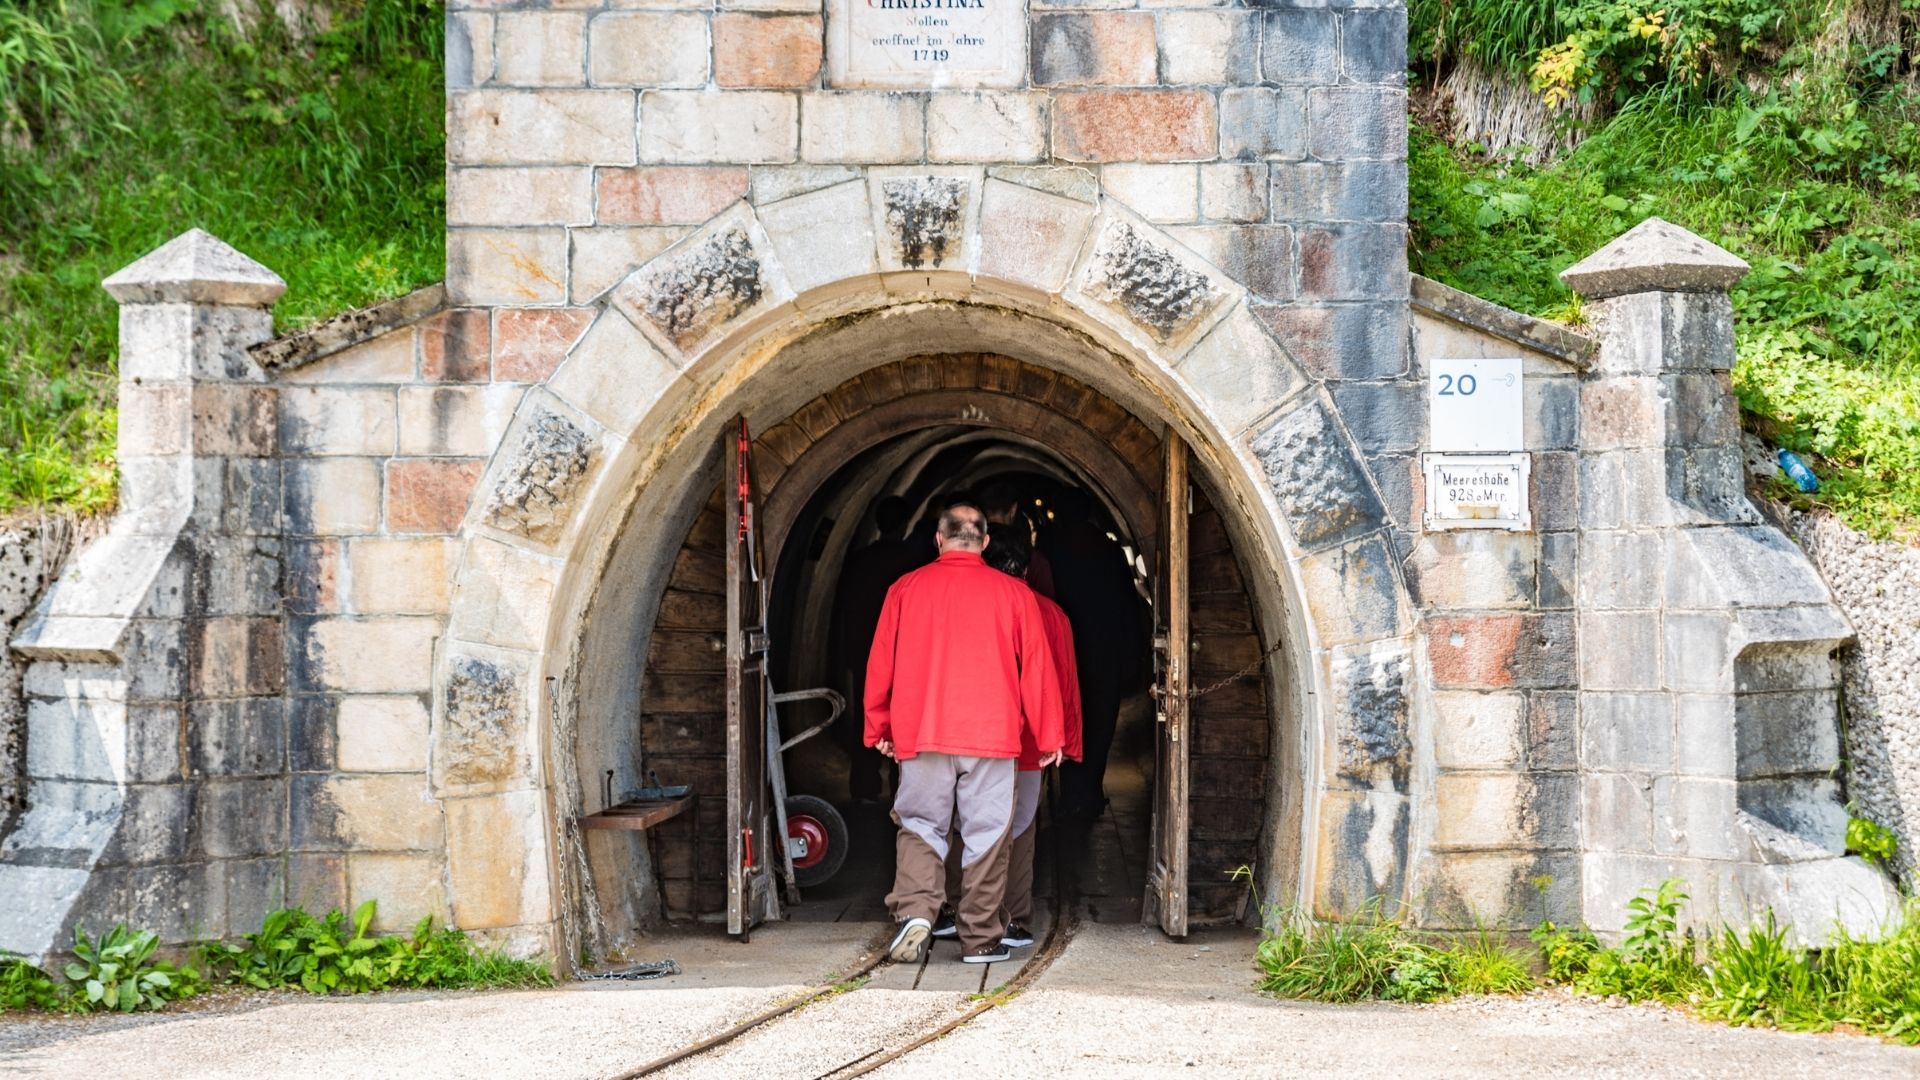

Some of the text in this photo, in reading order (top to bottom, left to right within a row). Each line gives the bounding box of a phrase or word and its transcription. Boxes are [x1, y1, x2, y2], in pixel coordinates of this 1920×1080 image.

[927, 35, 943, 47] im
[913, 49, 949, 61] 1719
[1438, 374, 1477, 396] 20
